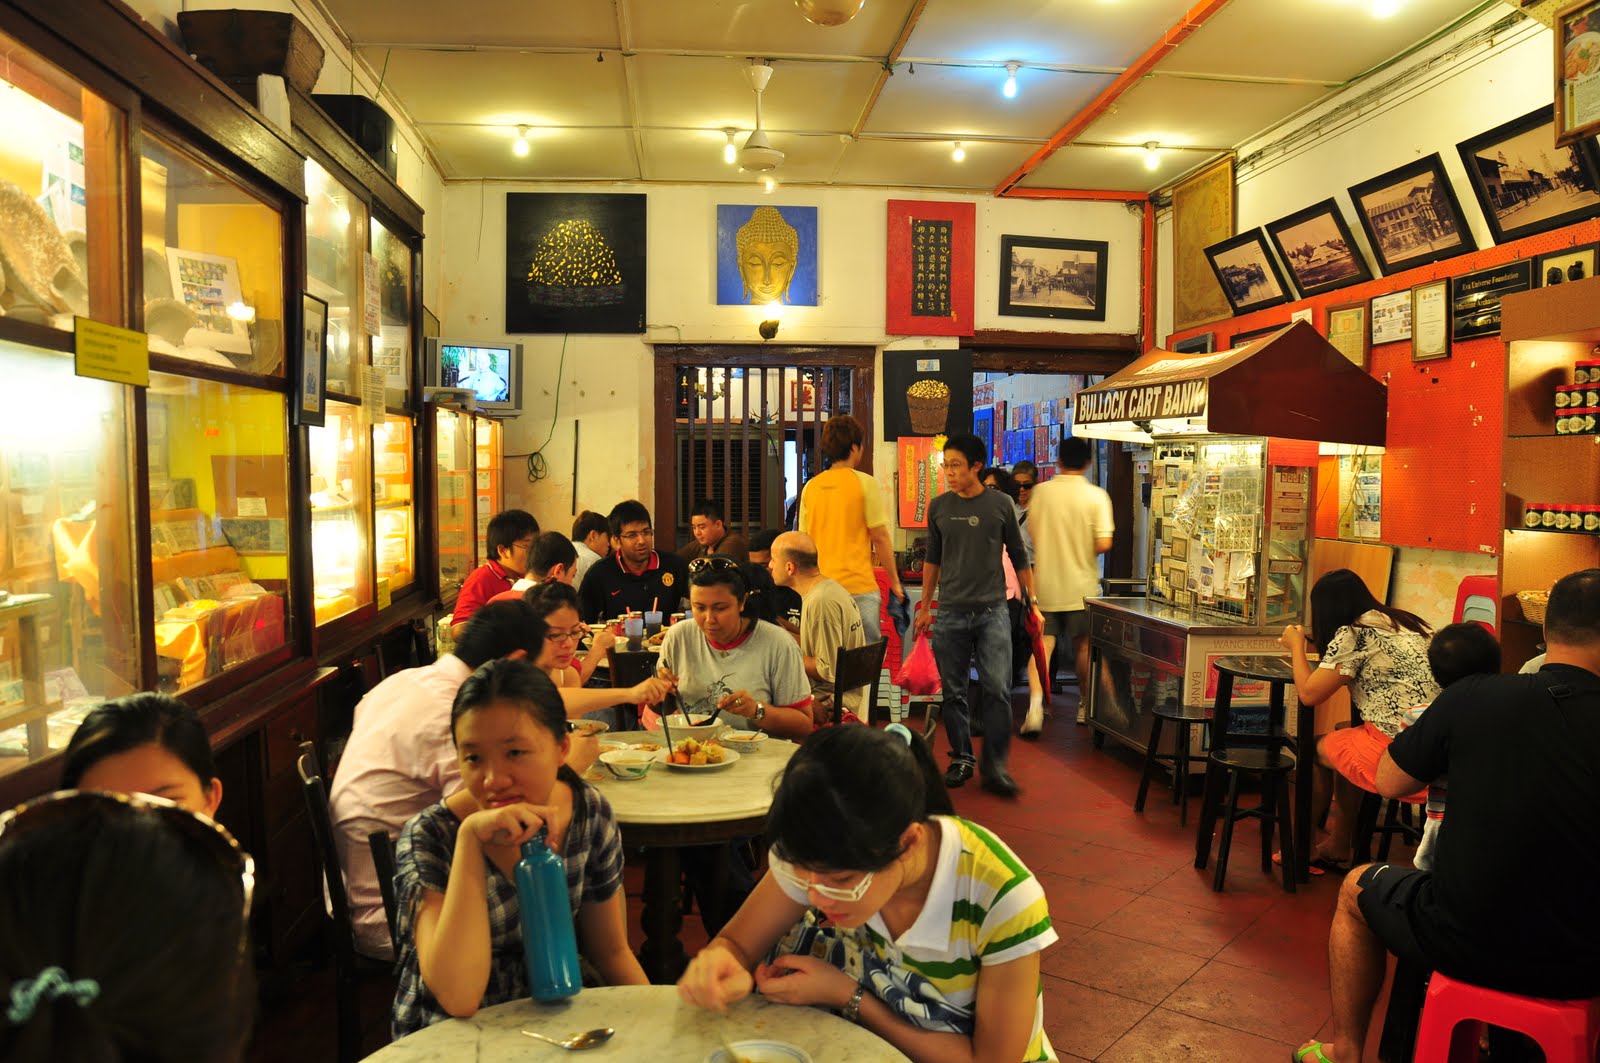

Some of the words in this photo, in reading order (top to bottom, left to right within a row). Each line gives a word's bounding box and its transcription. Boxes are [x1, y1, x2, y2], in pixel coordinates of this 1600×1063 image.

[1492, 273, 1519, 283] Foundation
[1079, 391, 1128, 421] BULLOCK
[1129, 387, 1162, 418] CART
[1162, 382, 1203, 415] BANK
[1214, 640, 1244, 649] WANG
[1245, 640, 1282, 649] KERTAS
